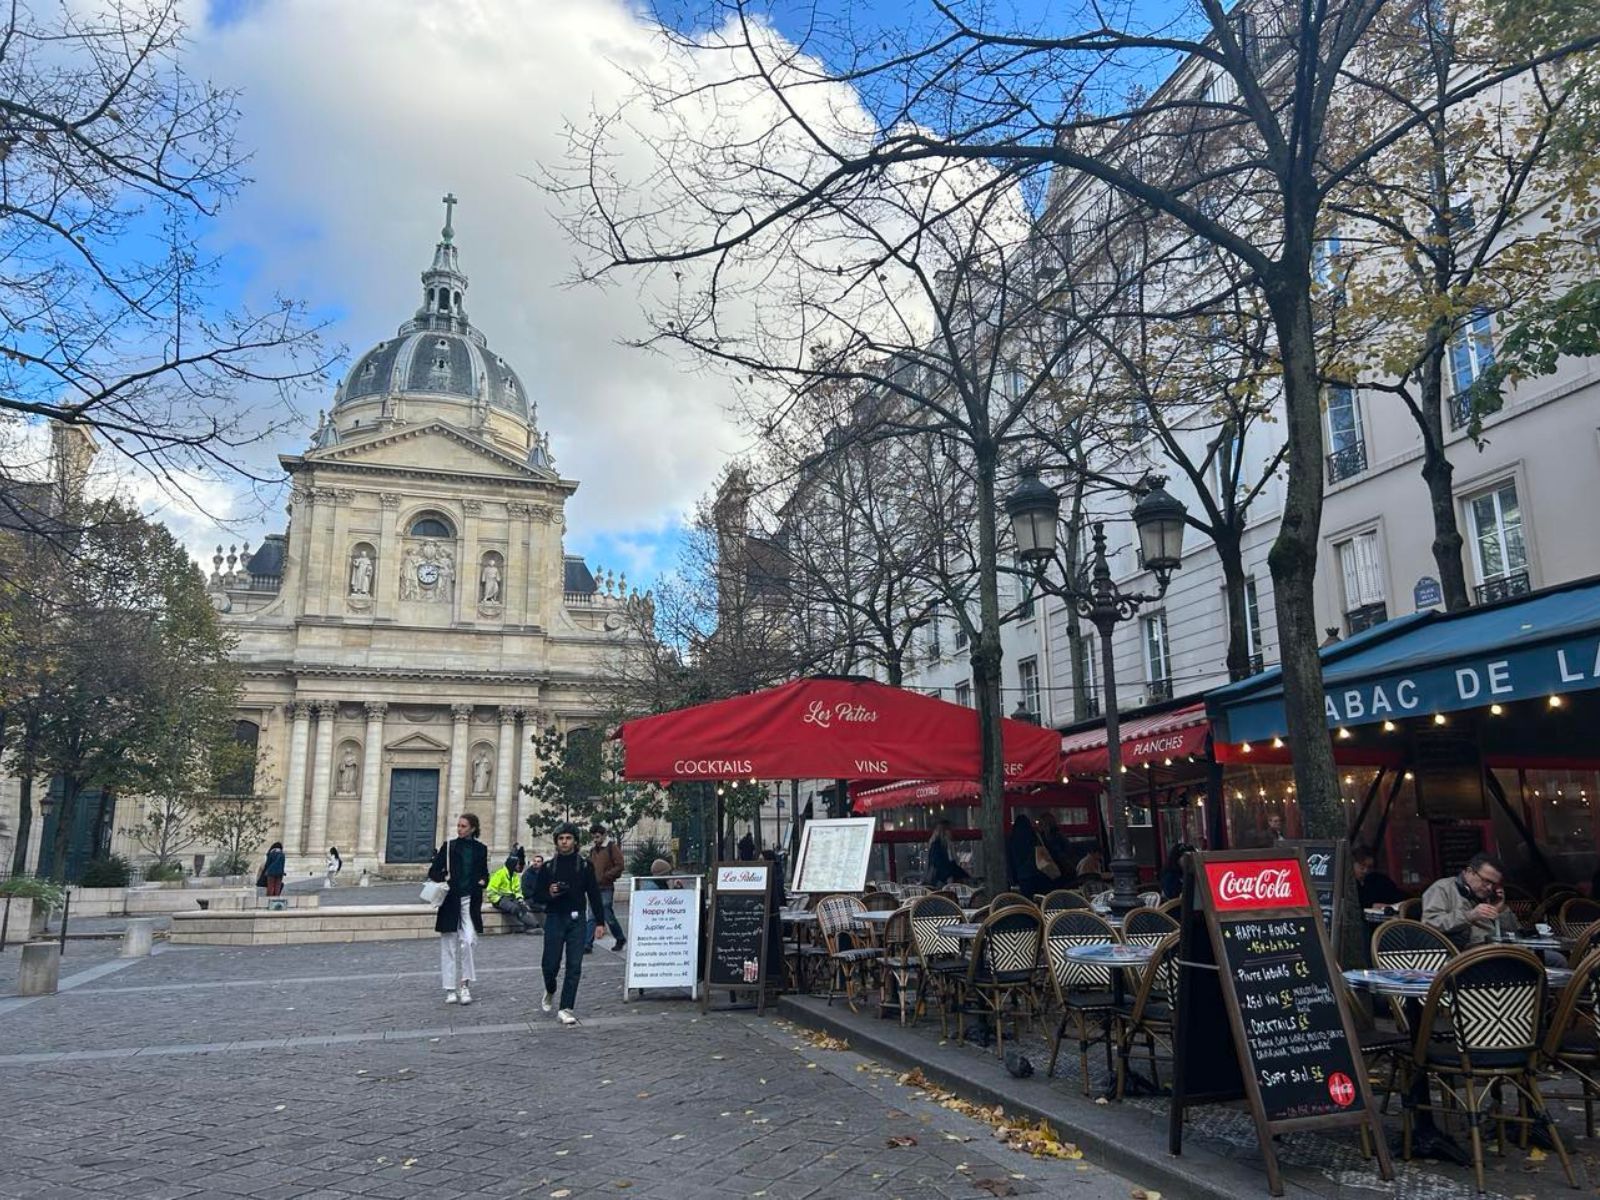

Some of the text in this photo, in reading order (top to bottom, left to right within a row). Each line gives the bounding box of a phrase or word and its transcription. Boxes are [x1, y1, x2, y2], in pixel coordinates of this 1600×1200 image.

[1324, 679, 1419, 721] ABAC
[1455, 660, 1513, 700] DE
[803, 700, 879, 728] Les Patios
[1133, 735, 1184, 756] PLANCHES
[674, 759, 1024, 776] COCKTAILS VINS RES
[1219, 868, 1292, 902] Coca-Cola
[642, 908, 666, 916] Happy
[1237, 968, 1263, 982] PINTE
[1261, 1069, 1287, 1087] SOFT
